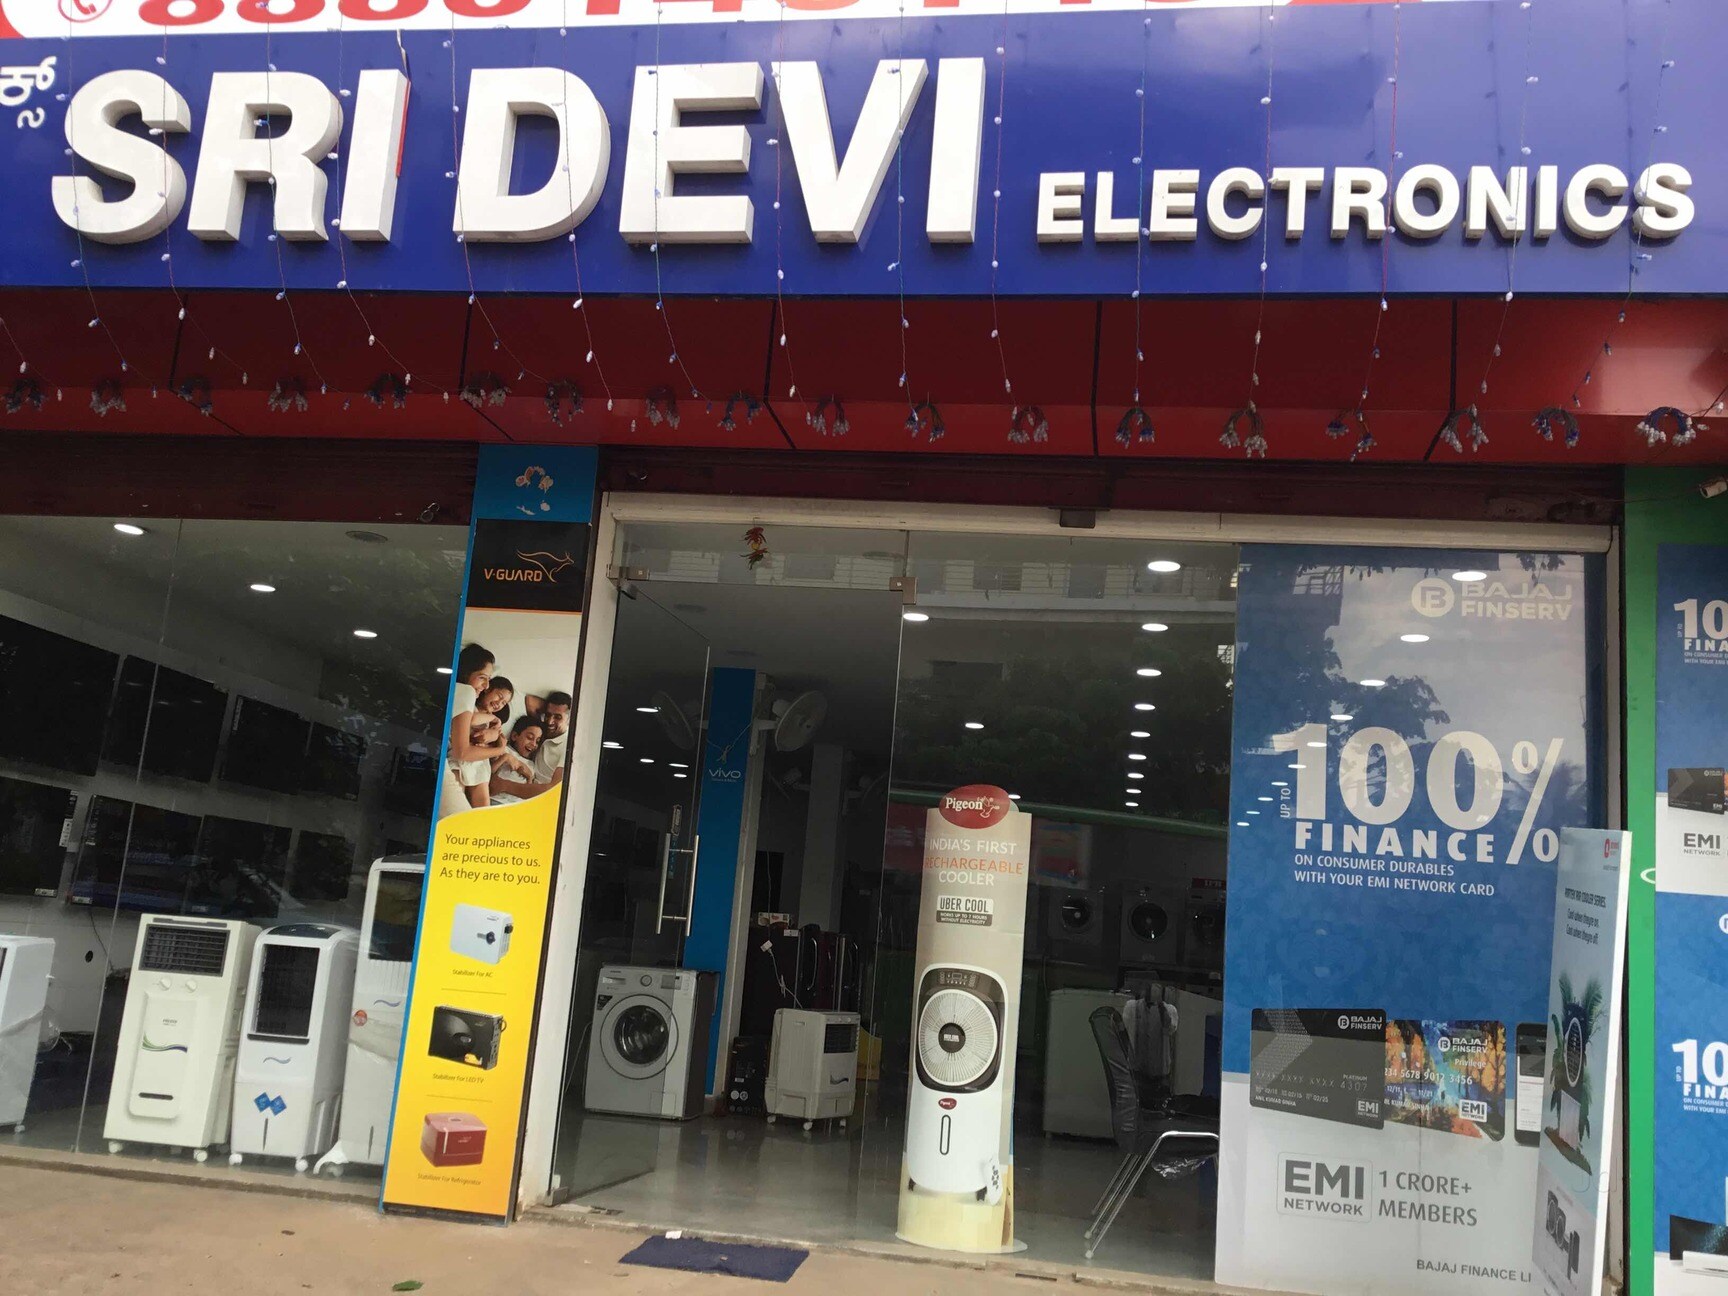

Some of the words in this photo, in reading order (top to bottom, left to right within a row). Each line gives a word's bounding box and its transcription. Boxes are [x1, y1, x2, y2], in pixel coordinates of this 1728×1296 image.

[52, 67, 407, 244] SRI
[453, 57, 986, 245] DEVI
[1036, 161, 1696, 243] ELECTRONICS
[1461, 581, 1572, 600] BAJAJ
[1461, 601, 1572, 620] FINSERV
[709, 768, 741, 778] vivo
[1272, 723, 1564, 865] 100%
[1281, 787, 1291, 802] TO
[945, 797, 983, 811] Pigeon
[1280, 803, 1291, 818] UP
[445, 833, 469, 845] Your
[471, 836, 531, 850] appliances
[929, 838, 971, 851] INDIA'S
[976, 840, 1017, 855] FIRST
[1295, 821, 1494, 863] FINANCE
[1683, 832, 1721, 849] EMI
[442, 852, 460, 862] are
[461, 853, 508, 865] precious
[511, 855, 523, 866] to
[526, 858, 541, 867] us.
[1683, 848, 1721, 857] NETWORK
[924, 856, 1024, 875] RECHARGEABLE
[1295, 854, 1313, 866] ON
[1317, 855, 1385, 871] CONSUMER
[1390, 861, 1454, 876] DURABLES
[440, 867, 453, 878] As
[456, 868, 480, 882] they
[482, 872, 500, 882] are
[503, 873, 514, 882] to
[517, 875, 541, 885] you.
[938, 871, 995, 886] COOLER
[1294, 870, 1326, 884] WITH
[1330, 873, 1363, 886] YOUR
[1368, 876, 1390, 889] EMI
[1395, 878, 1456, 894] NETWORK
[1460, 883, 1495, 896] CARD
[940, 897, 962, 910] UBER
[964, 898, 989, 913] COOL
[1452, 1037, 1488, 1046] BAJAJ
[1452, 1046, 1488, 1054] FINSERV
[1454, 1058, 1487, 1068] Privilege
[1343, 1073, 1368, 1081] PLATINUM
[1401, 1069, 1420, 1080] 5678
[1423, 1071, 1445, 1081] 9012
[1449, 1075, 1473, 1085] 3456
[1340, 1081, 1368, 1092] 4307
[1357, 1100, 1379, 1114] EMI
[1461, 1102, 1485, 1115] EMI
[1284, 1159, 1365, 1200] EMI
[1378, 1170, 1388, 1188] 1
[1395, 1171, 1472, 1196] CRORE+
[1284, 1197, 1363, 1216] NETWORK
[1378, 1199, 1478, 1227] MEMBERS
[1416, 1259, 1457, 1274] BAJAJ
[1461, 1264, 1516, 1281] FINANCE
